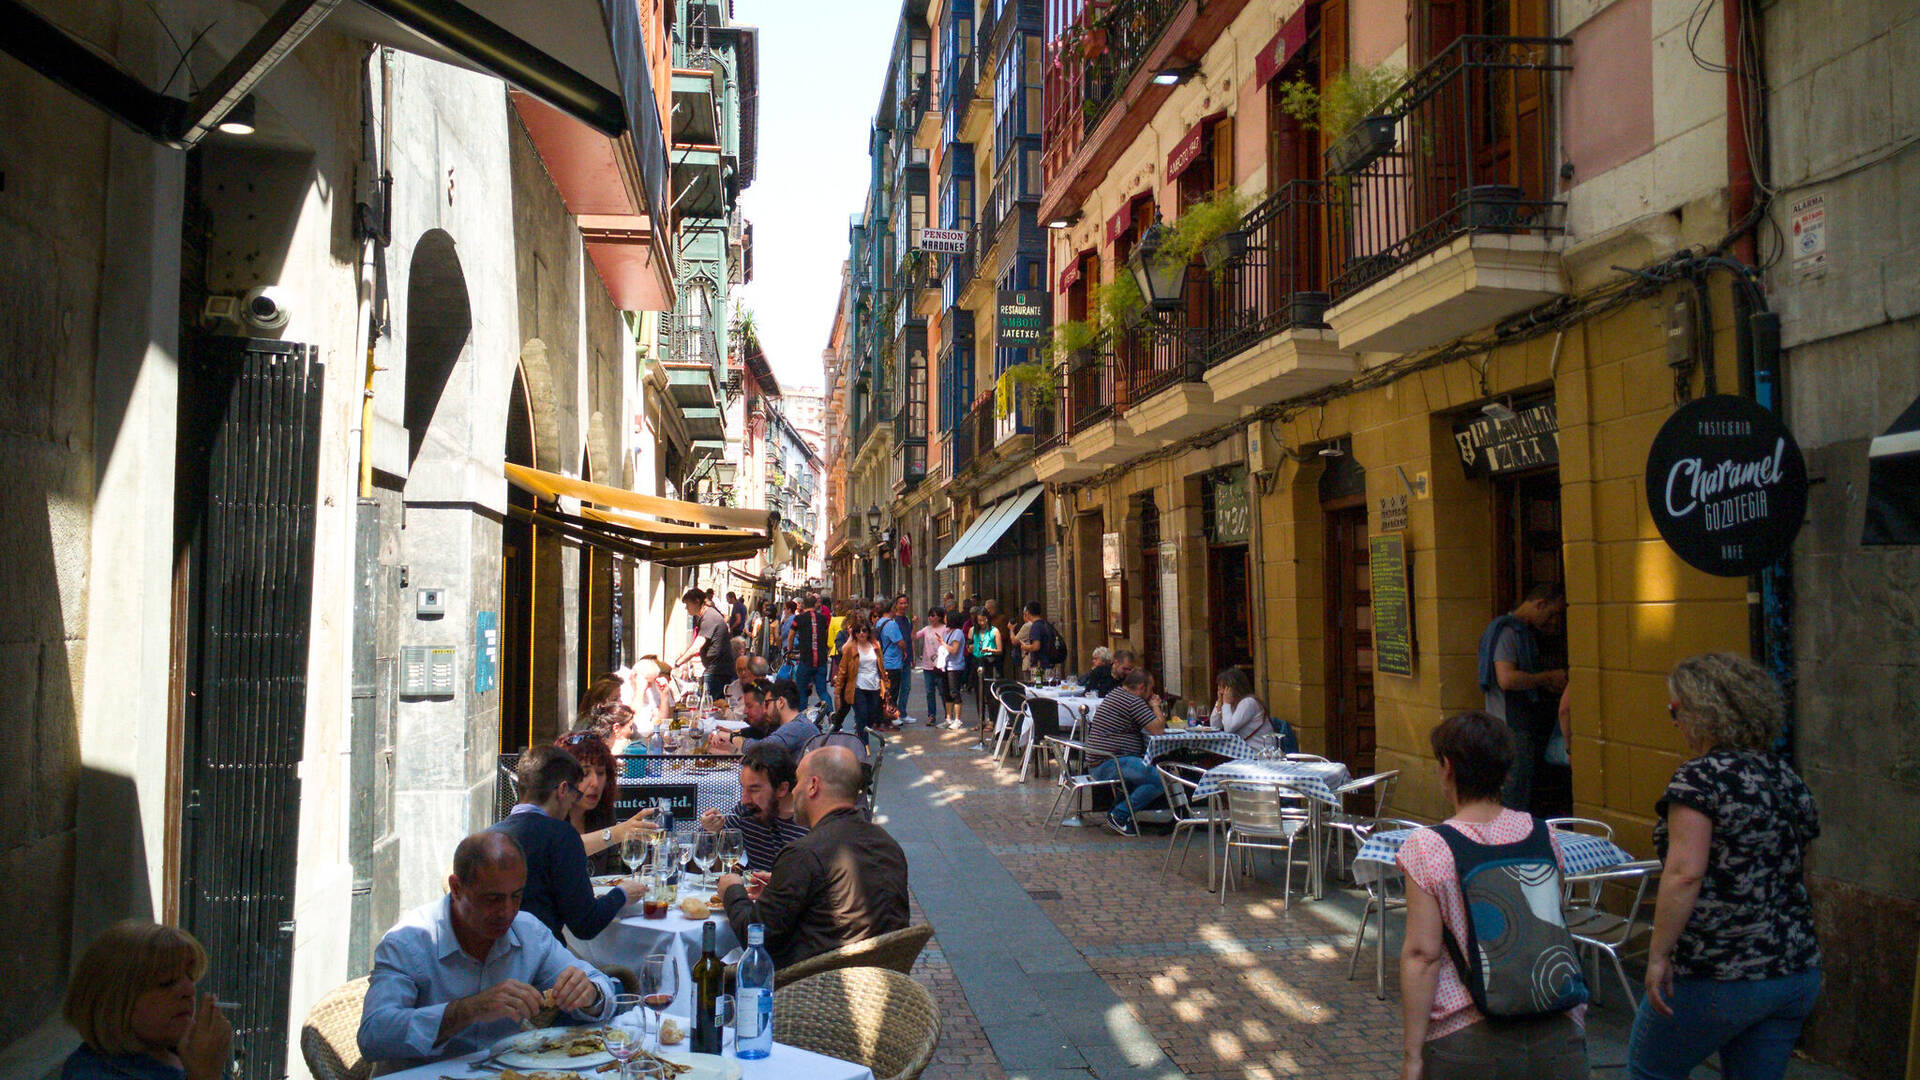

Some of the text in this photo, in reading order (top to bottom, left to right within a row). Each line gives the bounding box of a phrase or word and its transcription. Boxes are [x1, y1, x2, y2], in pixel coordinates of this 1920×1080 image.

[924, 230, 963, 241] PENSION
[1000, 304, 1041, 316] RESTAURANTE
[1001, 328, 1040, 338] JATETXEA
[1665, 437, 1785, 517] Charamel
[1704, 490, 1768, 531] GOZOTEGIA
